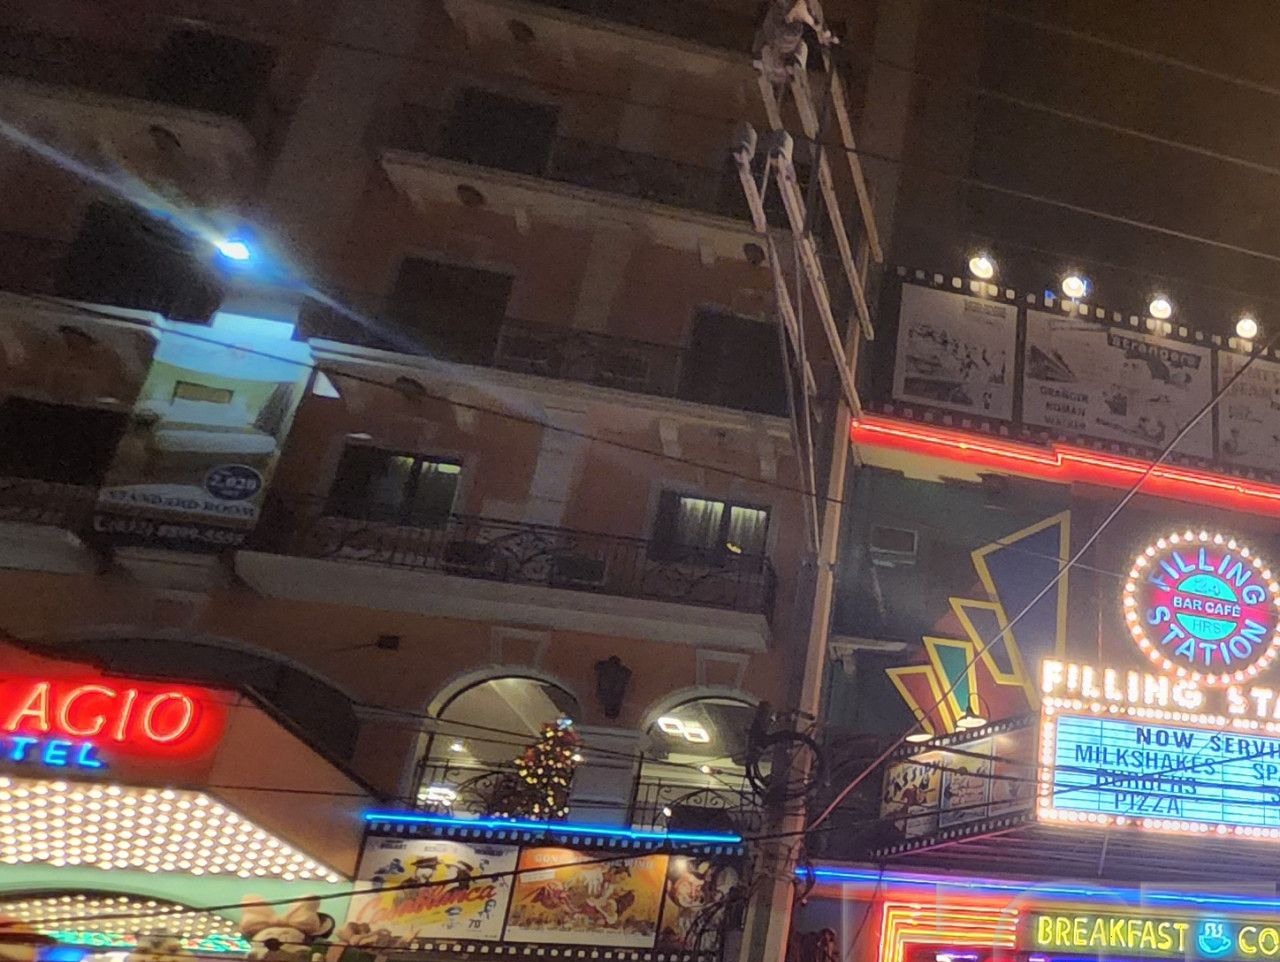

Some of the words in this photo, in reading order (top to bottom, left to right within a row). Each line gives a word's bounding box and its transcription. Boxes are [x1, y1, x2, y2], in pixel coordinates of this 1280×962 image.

[1148, 548, 1266, 605] FILLING
[1173, 596, 1202, 611] BAR
[1147, 606, 1267, 666] STATION
[1042, 660, 1204, 709] FILLING
[1136, 727, 1194, 749] NOW
[1075, 744, 1216, 776] MILKSHAKES
[1114, 793, 1180, 815] PIZZA
[1038, 916, 1189, 952] BREAKFAST
